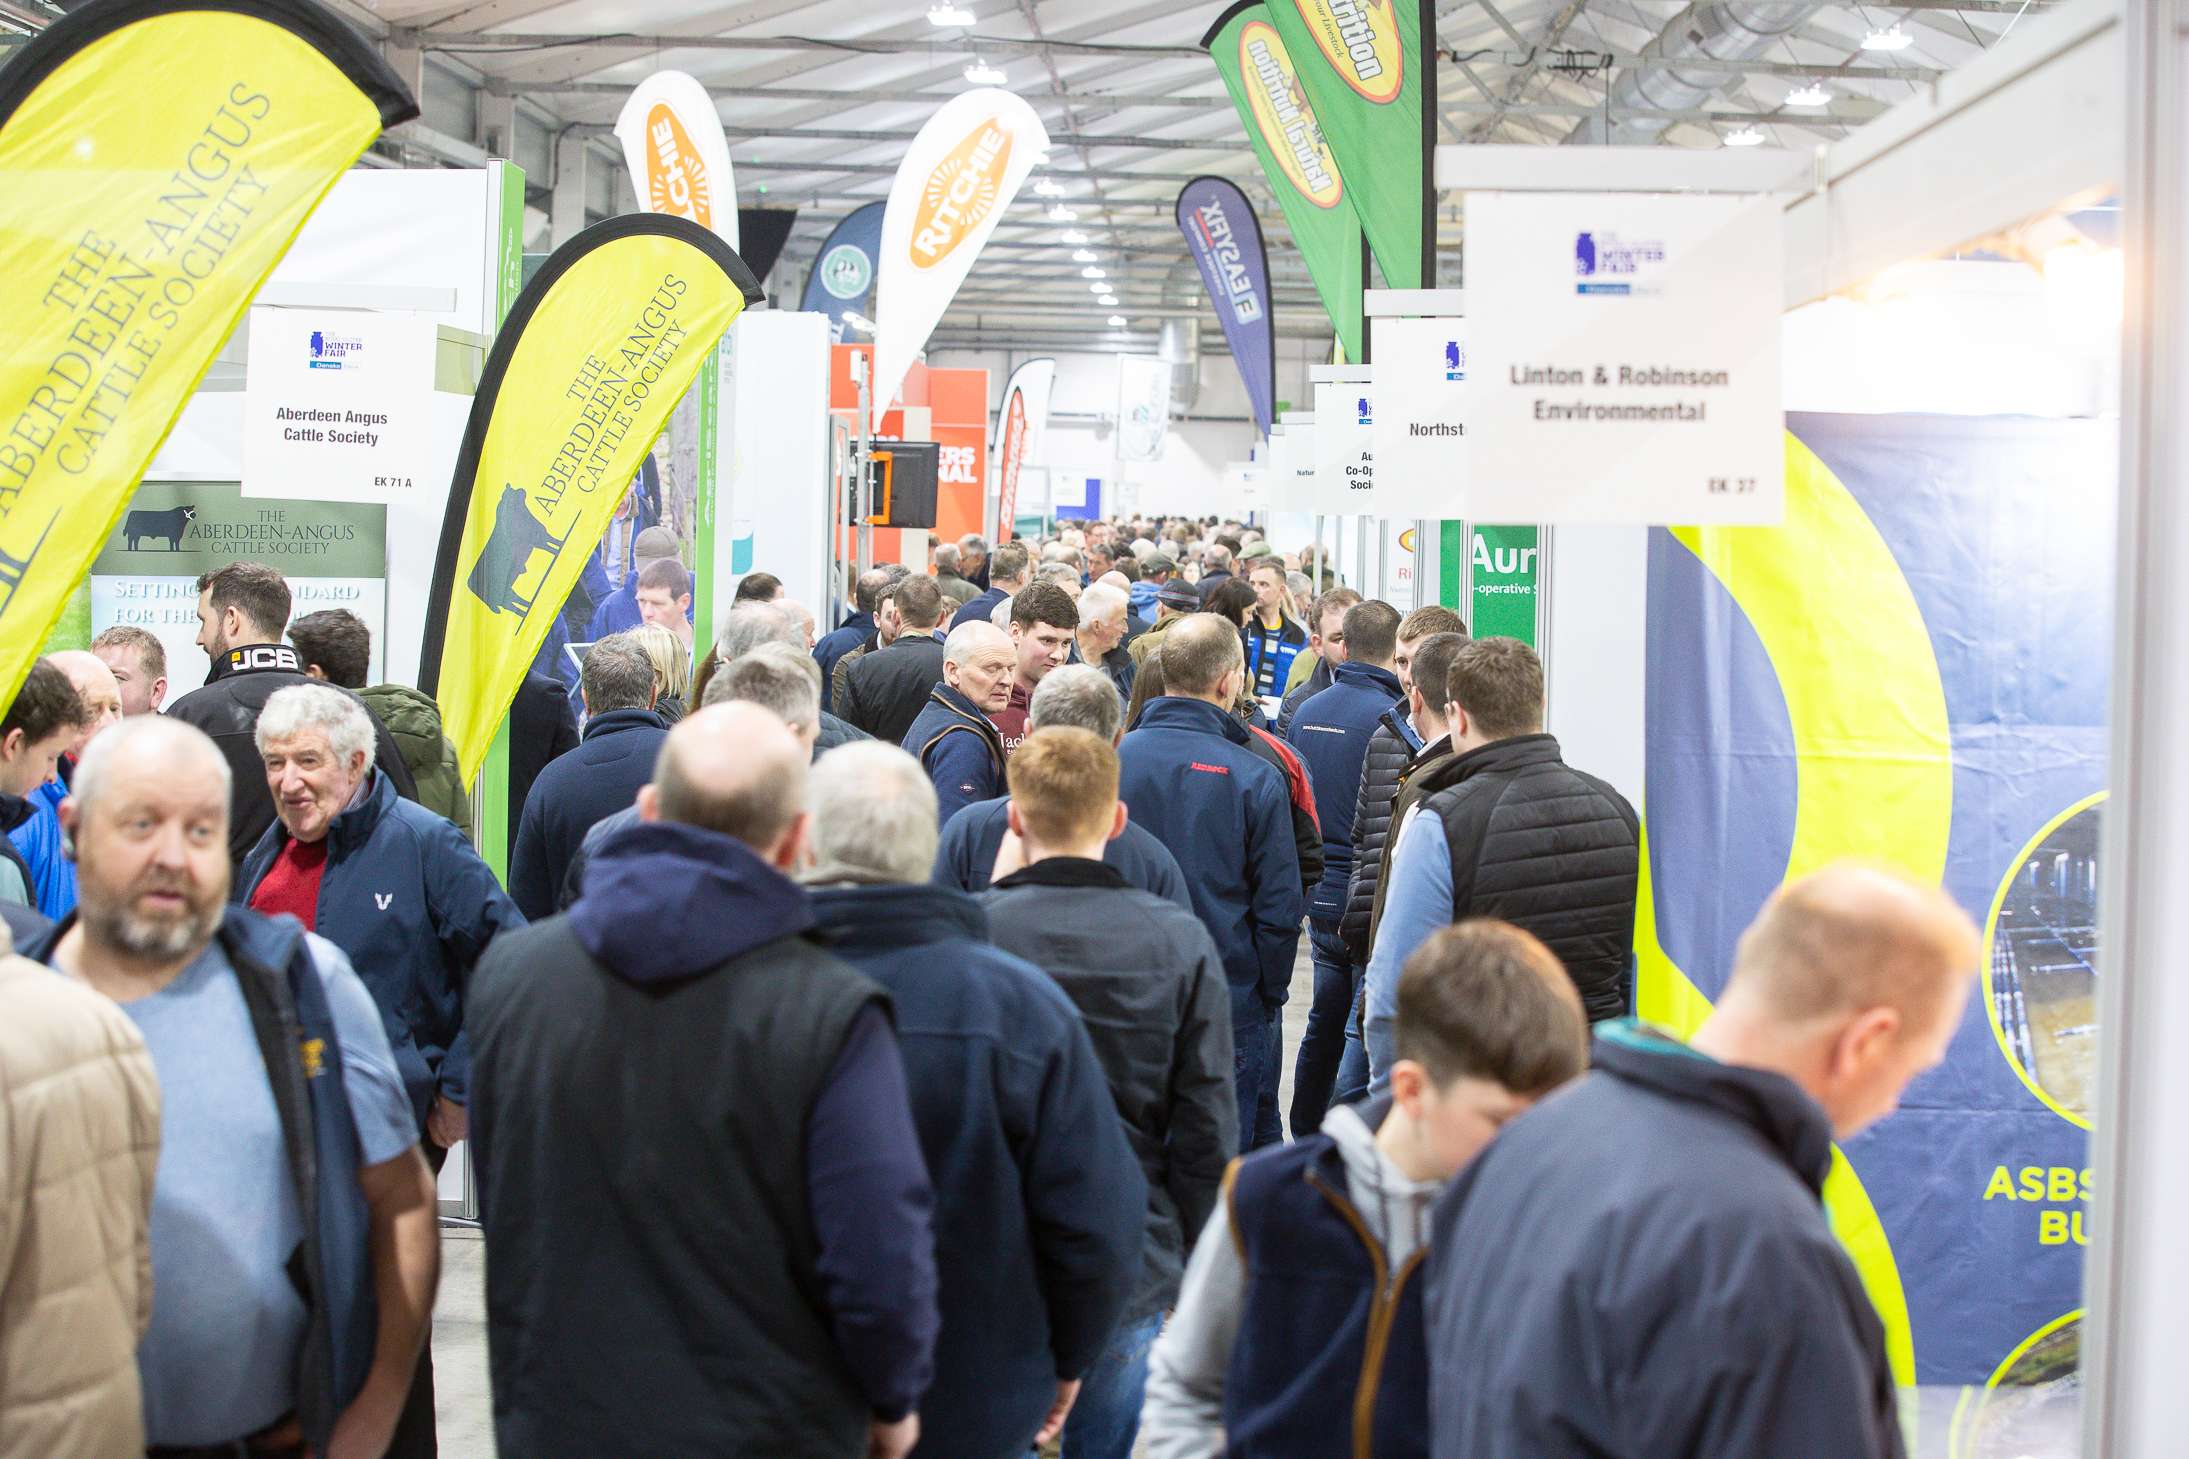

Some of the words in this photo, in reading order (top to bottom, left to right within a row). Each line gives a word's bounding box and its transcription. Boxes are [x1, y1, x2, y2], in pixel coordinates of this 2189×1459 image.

[1321, 18, 1345, 59] Livestock
[914, 126, 1006, 258] RITCHIE
[43, 229, 118, 313] THE
[56, 329, 164, 475] CATTLE
[147, 163, 271, 332] SOCIETY
[325, 342, 363, 351] WINTER
[566, 354, 607, 401] THE
[1510, 365, 1584, 386] Linton
[1592, 365, 1608, 386] &
[1619, 365, 1729, 386] Robinson
[534, 273, 688, 517] ABERDEEN-ANGUS
[276, 407, 341, 422] Aberdeen
[345, 410, 388, 427] Angus
[576, 410, 634, 494] CATTLE
[623, 319, 688, 413] SOCIETY
[1533, 400, 1706, 421] Environmental
[284, 427, 324, 442] Cattle
[328, 429, 378, 447] Society
[374, 477, 387, 486] EK
[390, 478, 401, 487] 71
[405, 478, 412, 487] A
[257, 509, 286, 522] THE
[189, 523, 355, 541] ABERDEEN-ANGUS
[211, 541, 265, 554] CATTLE
[268, 541, 331, 555] SOCIETY
[1472, 533, 1537, 574] Aur
[1472, 583, 1531, 597] -operative
[115, 607, 154, 624] FOR
[231, 648, 299, 671] JCB
